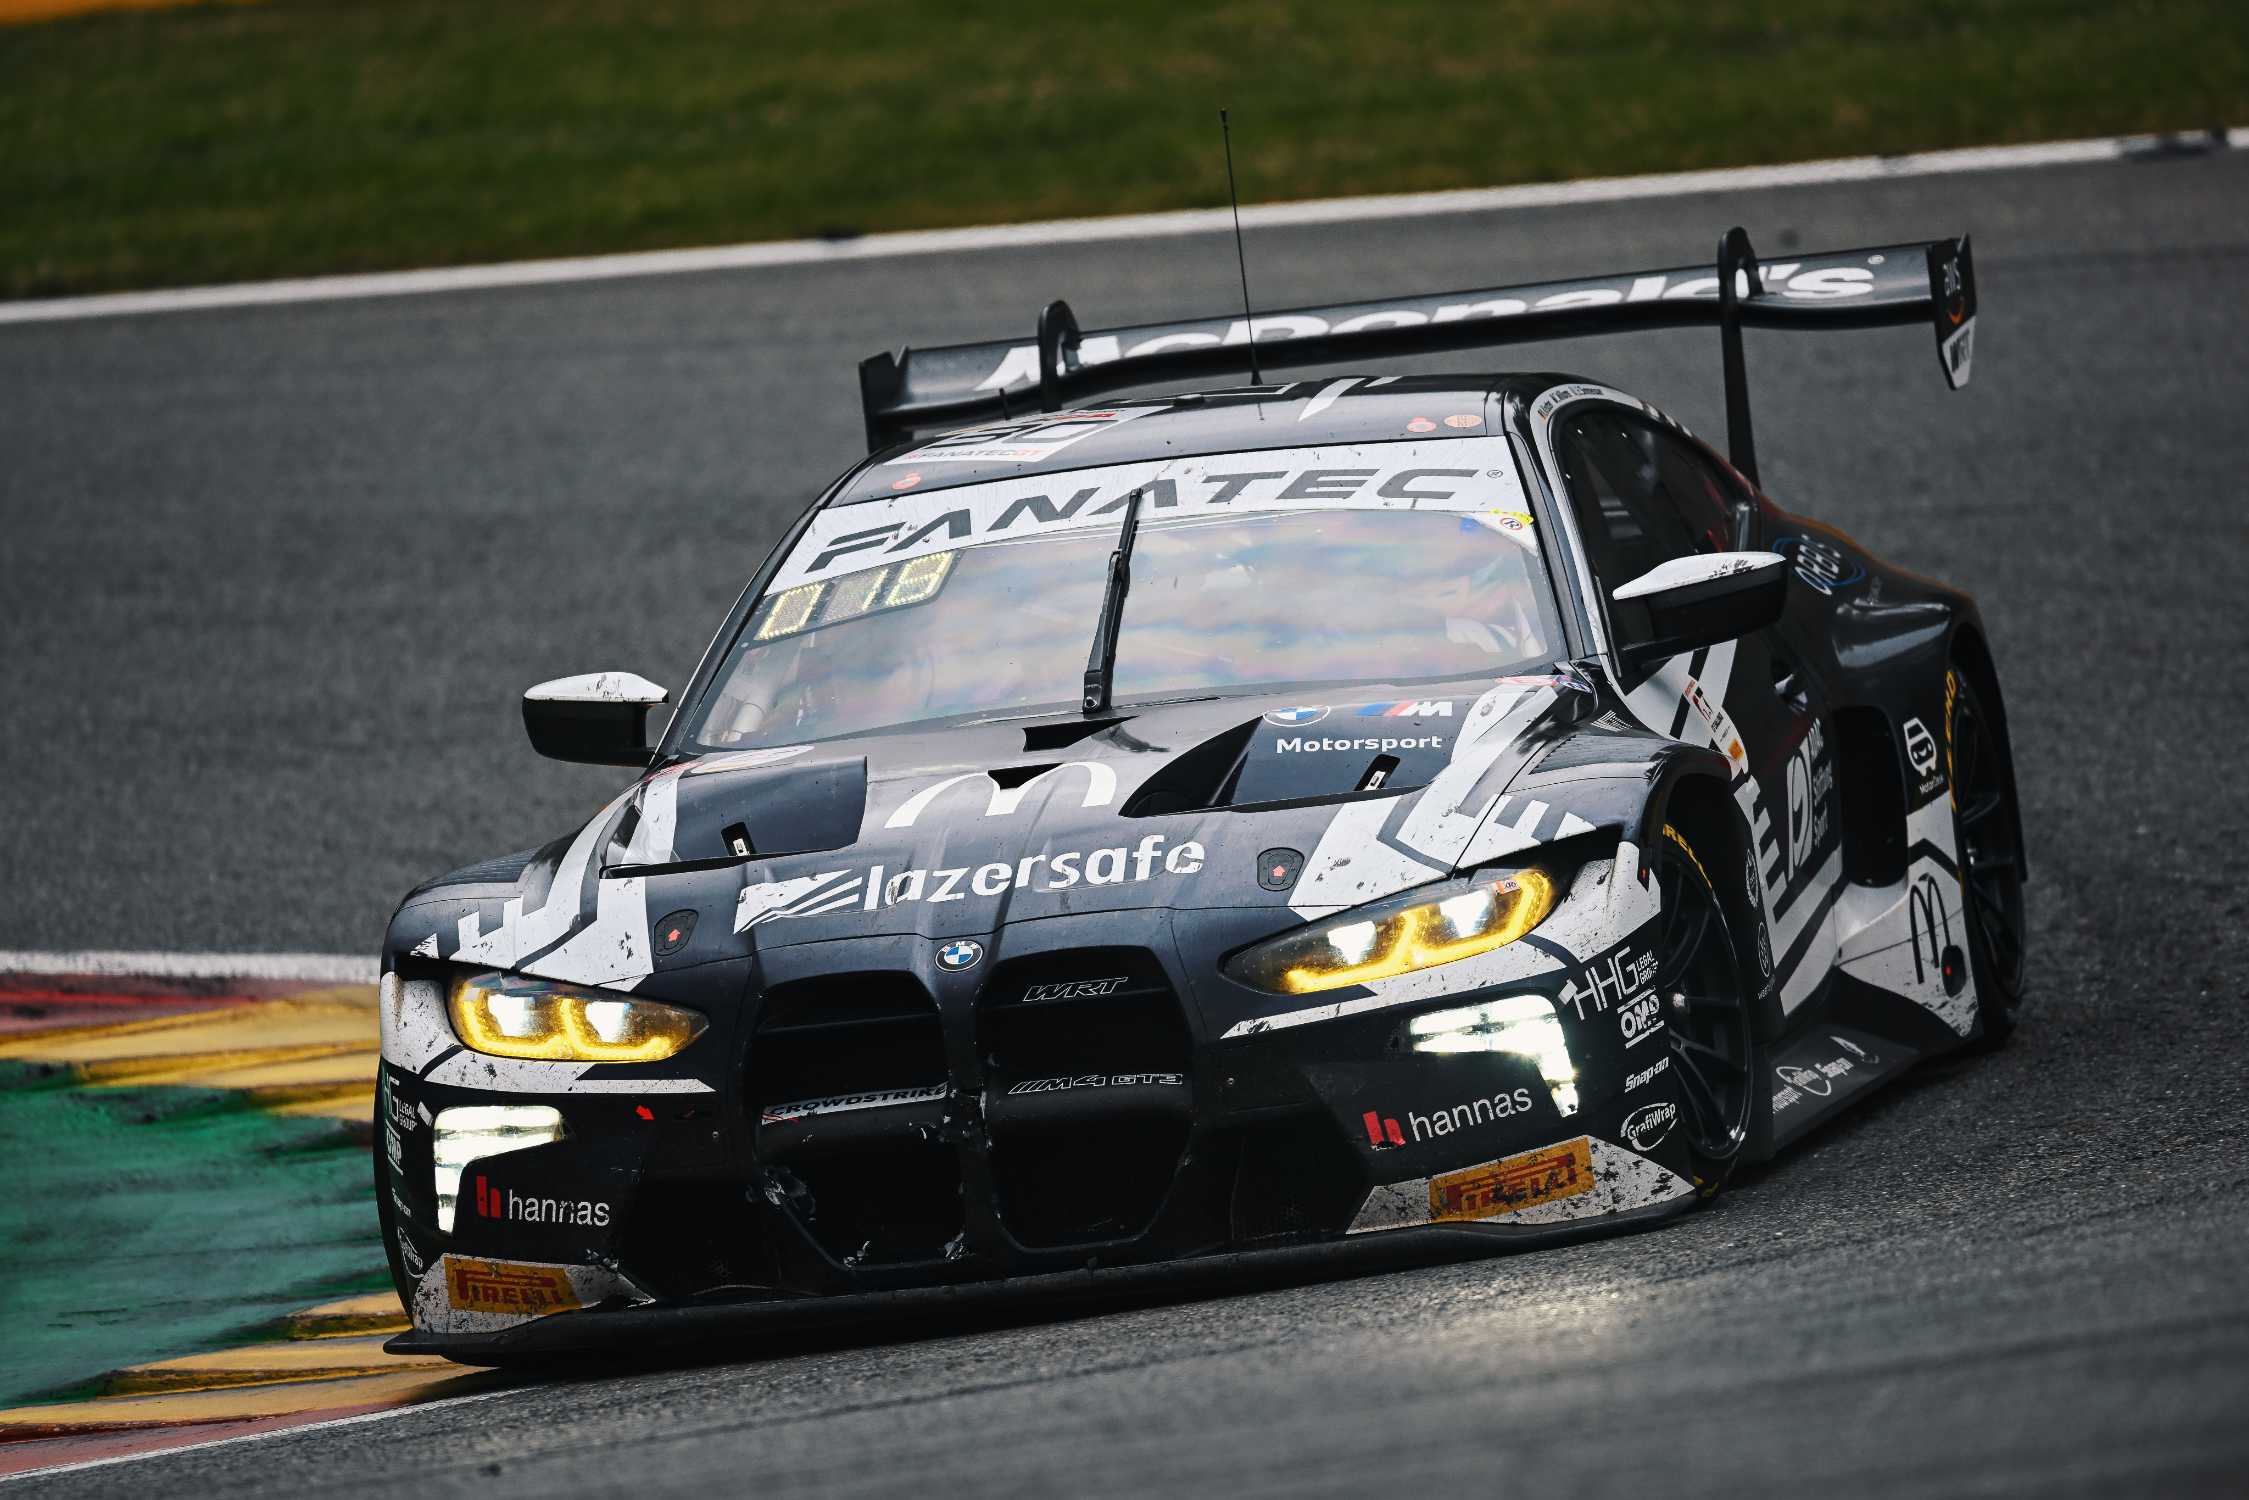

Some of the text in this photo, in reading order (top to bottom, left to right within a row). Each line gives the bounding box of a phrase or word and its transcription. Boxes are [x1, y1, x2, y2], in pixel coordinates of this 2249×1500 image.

[804, 468, 1480, 574] FANATEC
[1276, 734, 1443, 754] Motorsport
[863, 834, 1206, 911] lazersafe
[1023, 976, 1129, 1002] WRT
[1571, 946, 1641, 1021] HHG
[1111, 1073, 1183, 1087] GT3
[1408, 1086, 1533, 1142] hannas
[1627, 1102, 1677, 1142] GrafiWrap
[508, 1188, 611, 1228] hannas
